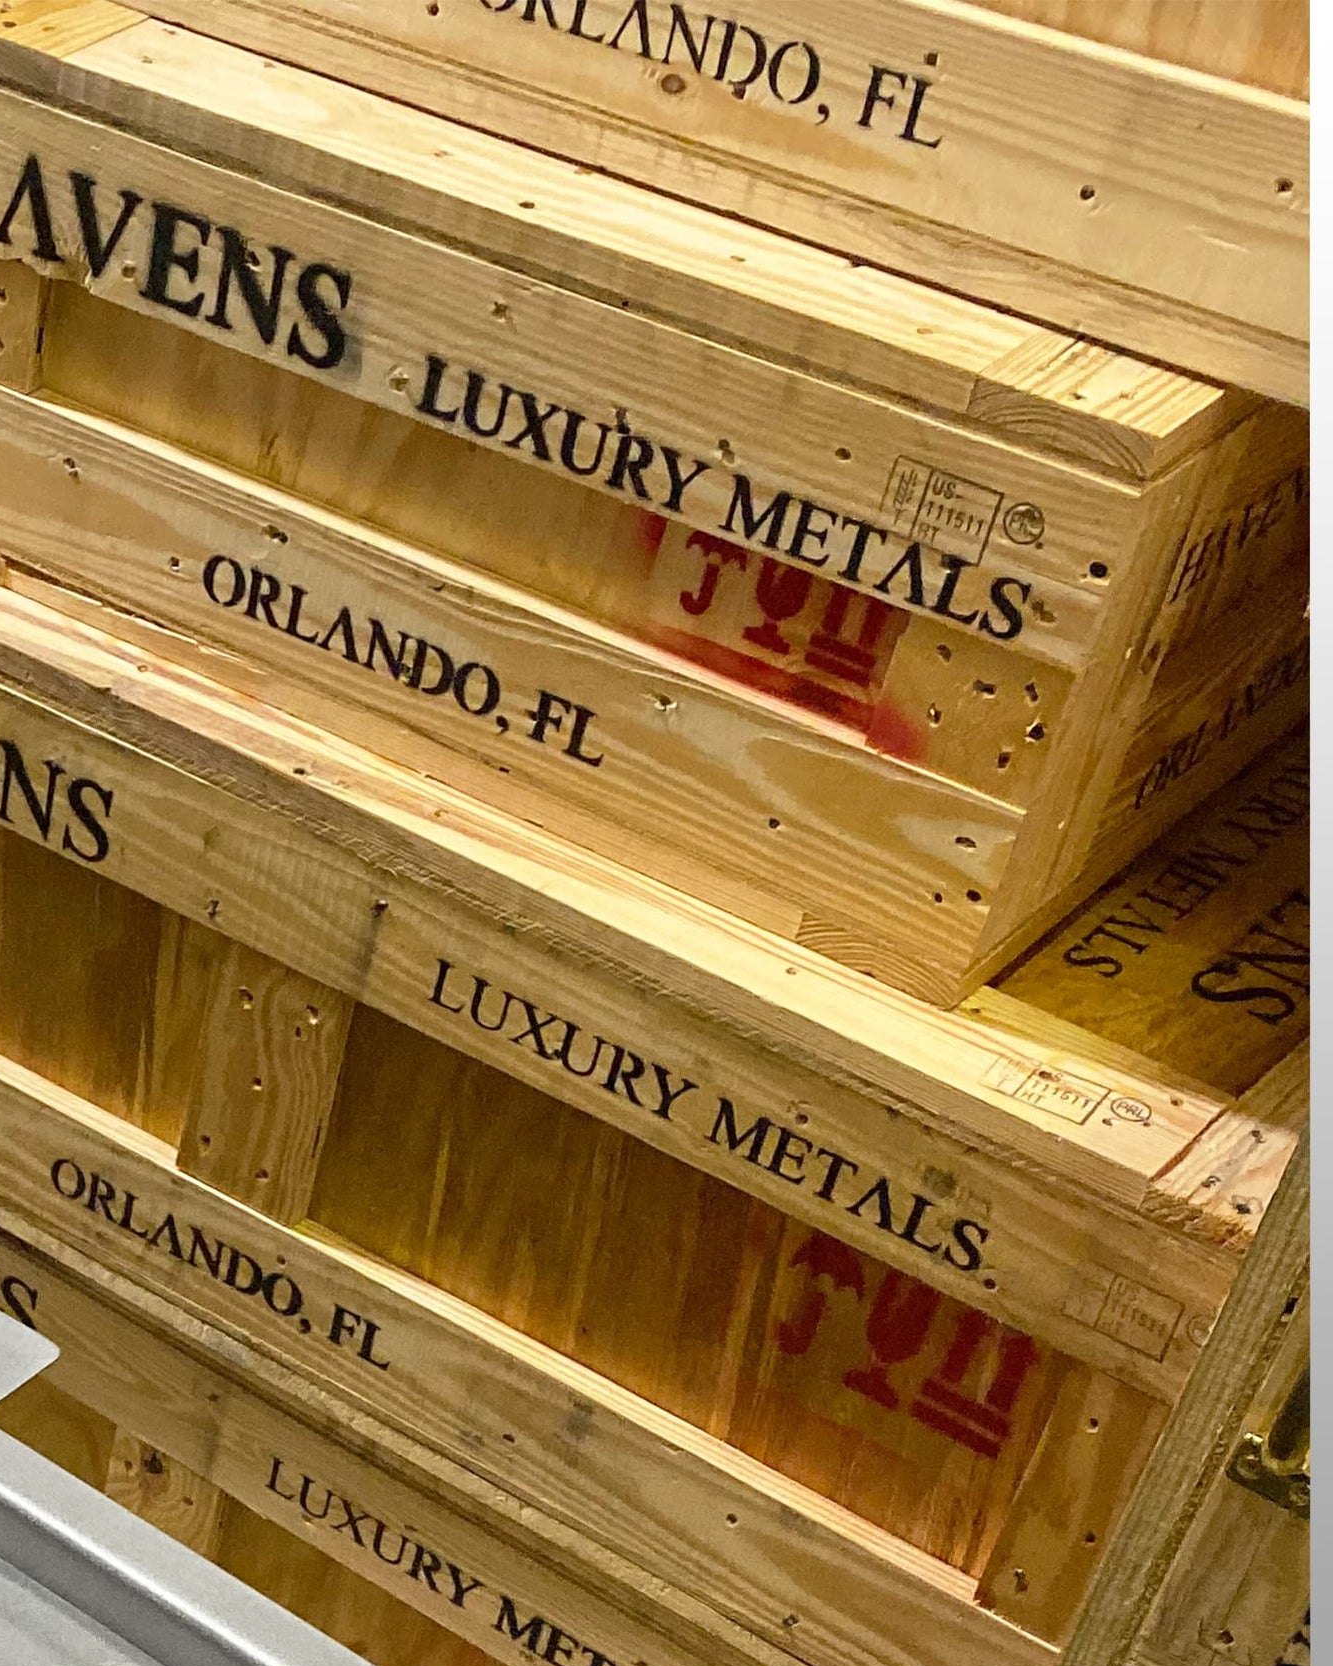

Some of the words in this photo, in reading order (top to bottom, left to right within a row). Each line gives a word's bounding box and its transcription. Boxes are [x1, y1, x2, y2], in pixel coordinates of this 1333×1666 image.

[479, 0, 830, 127] LANDO,
[856, 61, 943, 150] FL
[414, 355, 712, 514] LUXURY
[719, 474, 1031, 642] METALS
[202, 554, 510, 735] ORLANDO,
[527, 689, 605, 768] FL
[428, 958, 700, 1120] LUXURY
[50, 1157, 314, 1334] ORLANDO,
[328, 1306, 391, 1371] FL
[264, 1456, 483, 1608] LUXURY
